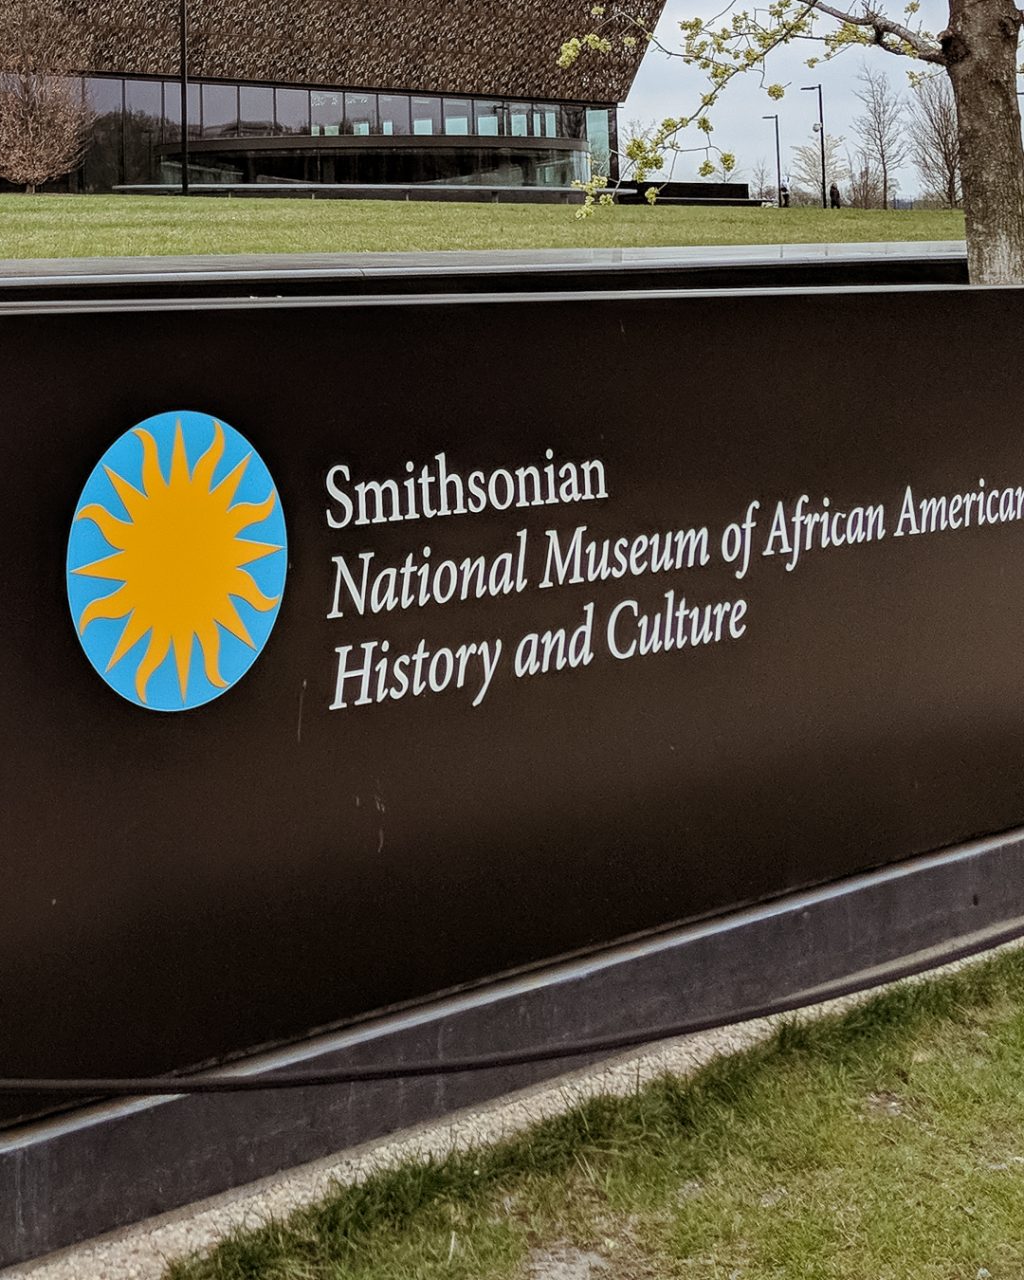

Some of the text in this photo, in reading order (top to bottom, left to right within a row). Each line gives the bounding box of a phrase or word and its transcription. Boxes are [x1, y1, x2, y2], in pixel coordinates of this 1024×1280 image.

[325, 449, 609, 529] Smithsonian
[326, 529, 528, 619] National
[539, 525, 711, 589] Museum
[721, 500, 760, 580] of
[762, 494, 886, 572] African
[328, 589, 748, 711] History and Culture
